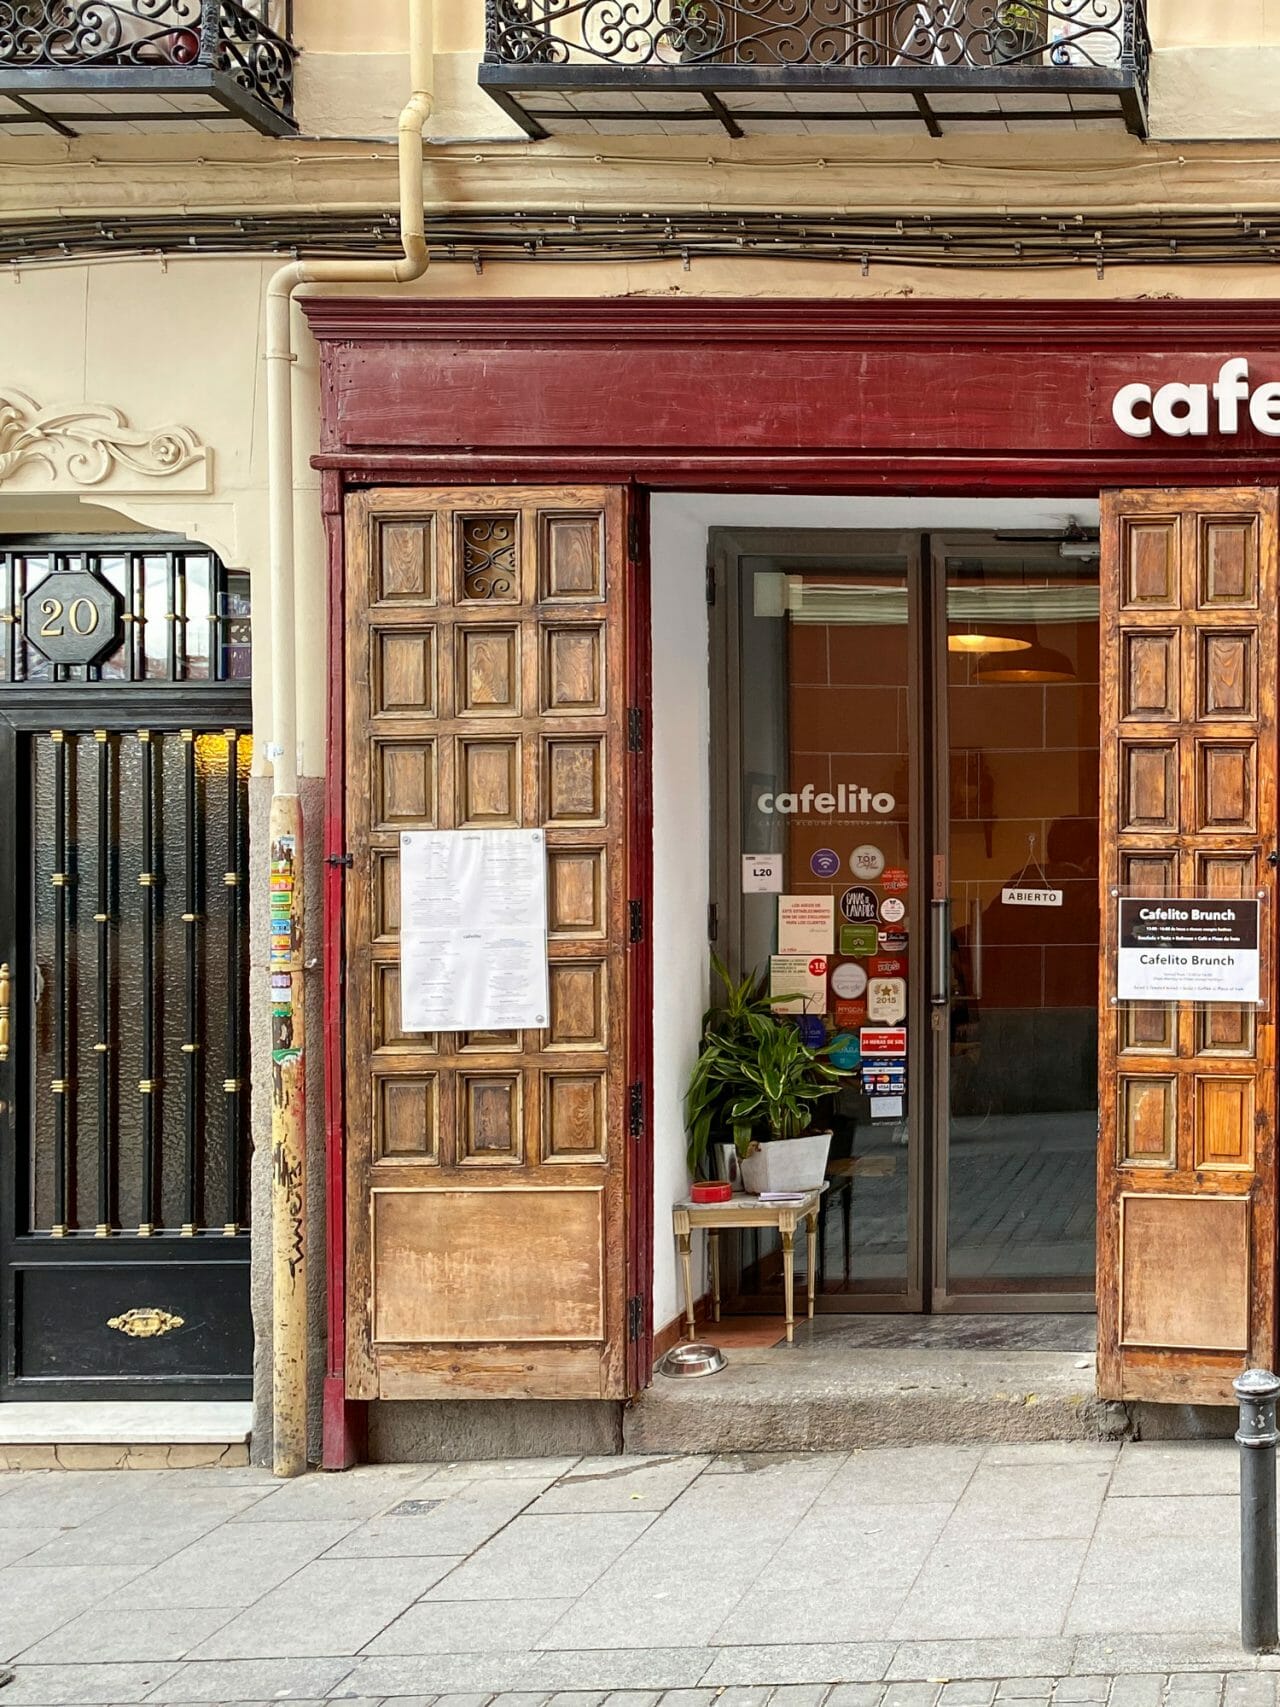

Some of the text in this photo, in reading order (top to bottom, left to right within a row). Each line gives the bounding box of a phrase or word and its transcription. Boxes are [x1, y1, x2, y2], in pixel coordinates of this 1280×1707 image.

[40, 598, 99, 637] 20
[757, 783, 896, 814] cafelito
[753, 868, 772, 877] L20
[1008, 892, 1056, 902] ABIERTO
[1139, 908, 1236, 921] Cafelito Brunch
[1139, 954, 1235, 966] Cafelito Brunch
